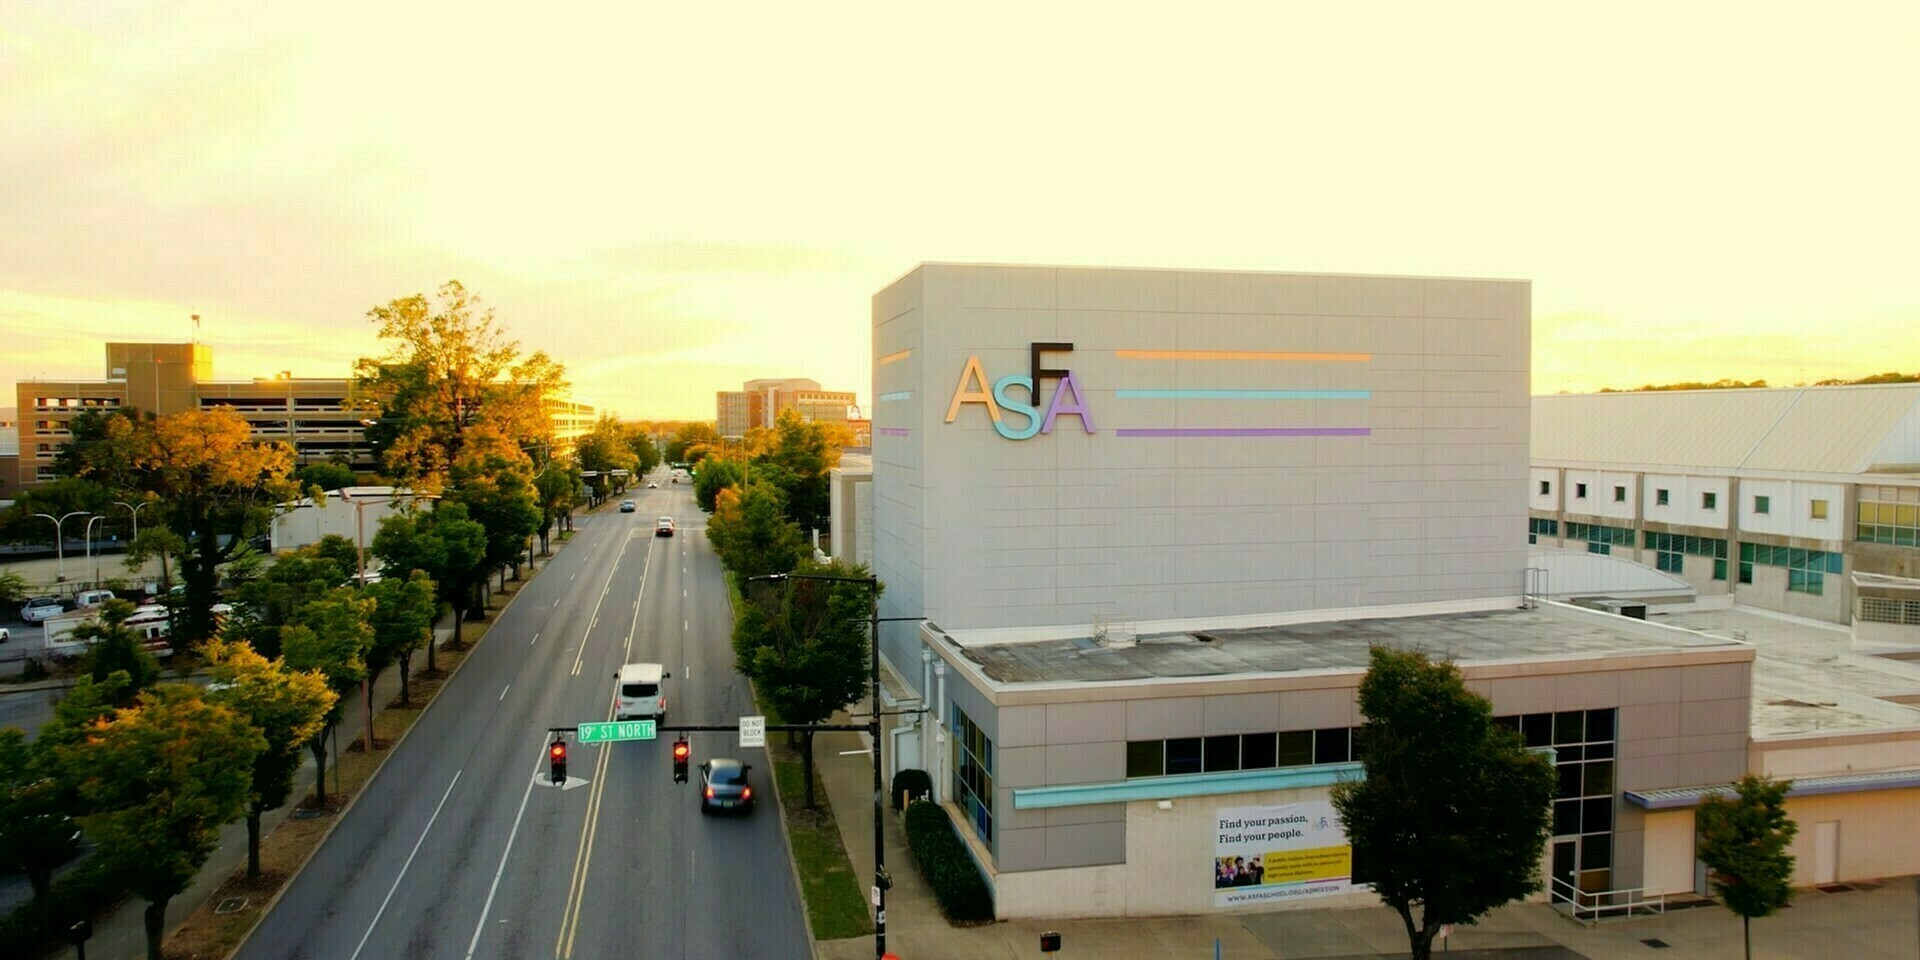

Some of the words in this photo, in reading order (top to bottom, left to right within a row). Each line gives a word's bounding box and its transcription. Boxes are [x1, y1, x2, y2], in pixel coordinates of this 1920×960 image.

[945, 342, 1095, 440] ASFA
[752, 719, 763, 727] NOT
[600, 725, 613, 739] ST
[618, 723, 654, 738] NORTH
[743, 729, 761, 737] BLOCK
[1219, 819, 1242, 829] Find
[1244, 818, 1266, 829] your
[1219, 833, 1242, 844] Find
[1244, 833, 1266, 843] your
[1268, 828, 1304, 841] people.
